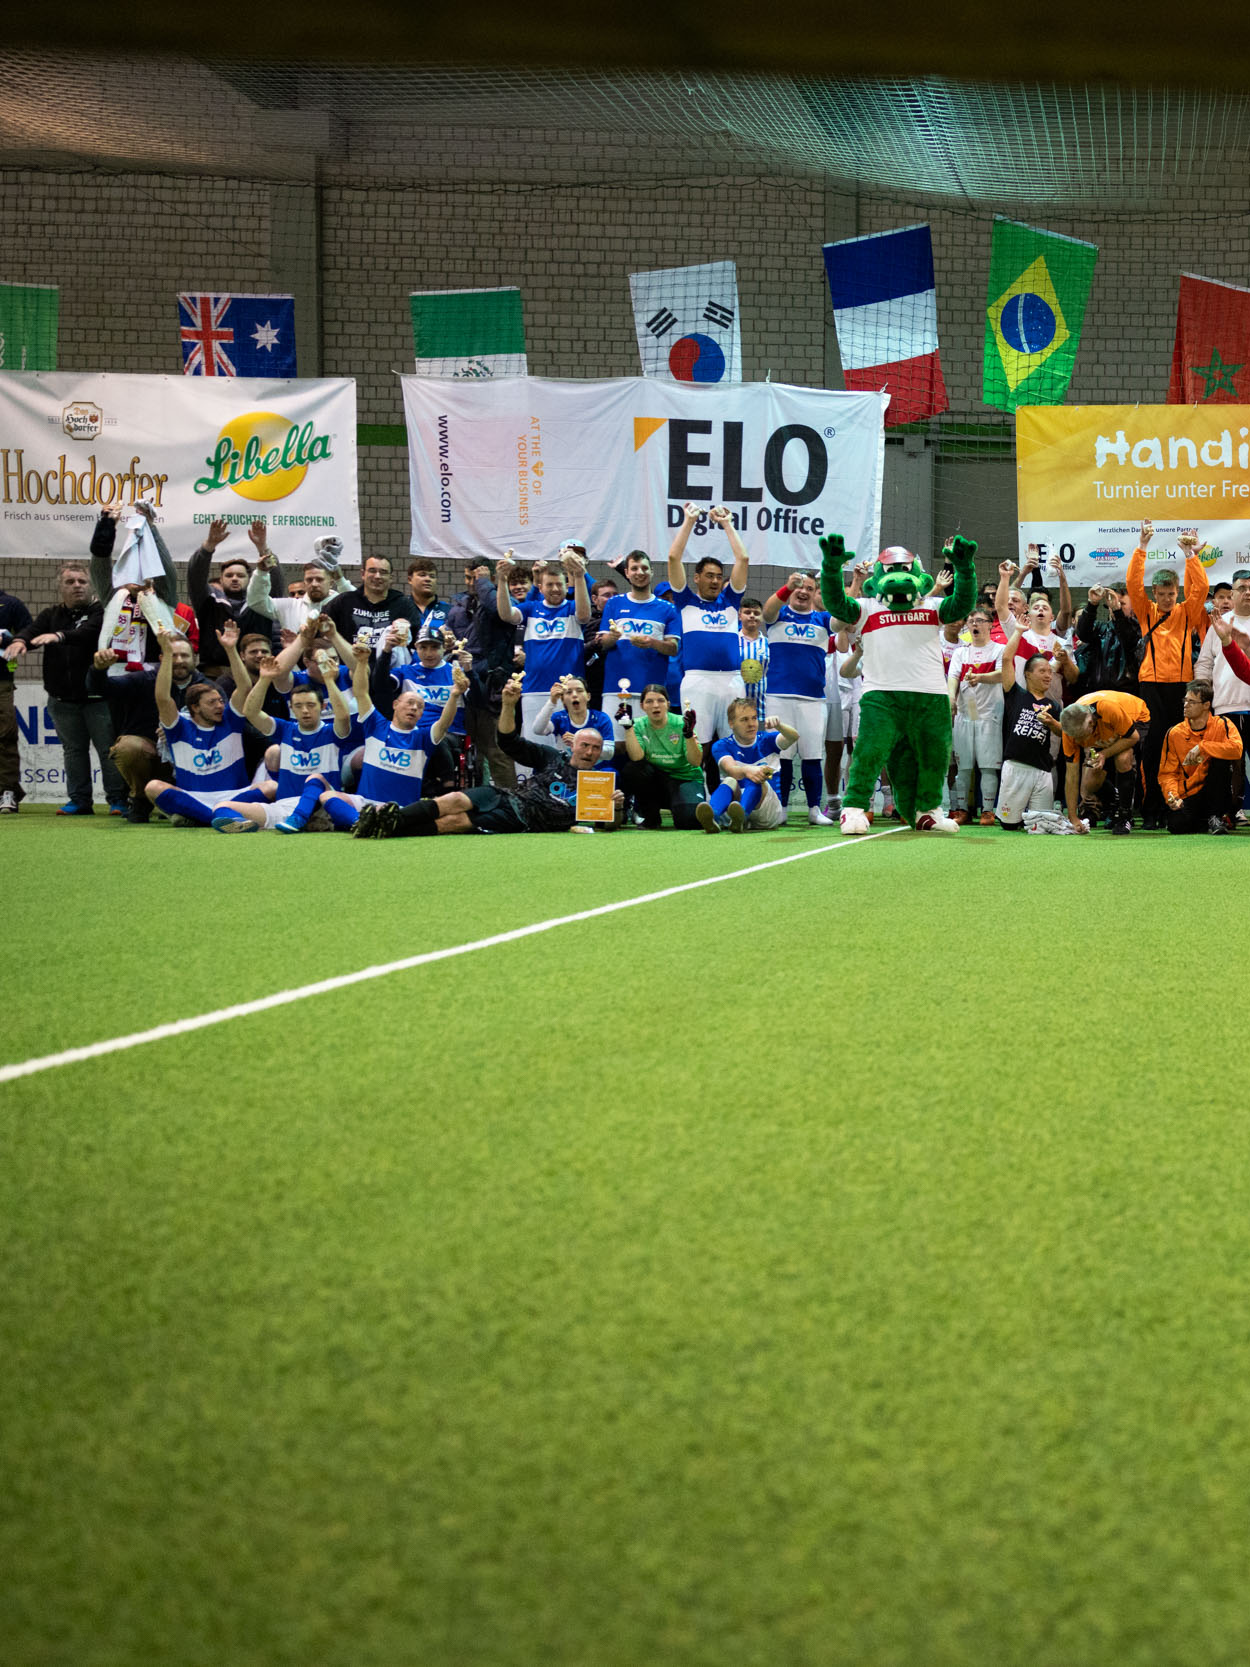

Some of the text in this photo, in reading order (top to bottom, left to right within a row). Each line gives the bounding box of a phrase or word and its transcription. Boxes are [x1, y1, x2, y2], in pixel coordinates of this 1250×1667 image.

[193, 420, 331, 494] Libella
[530, 416, 542, 496] AT THE OF
[668, 418, 828, 506] ELO
[438, 415, 453, 523] www.elo.com
[0, 449, 168, 507] Hochdorfer
[517, 434, 529, 526] YOUR BUSINESS
[1093, 481, 1160, 498] Turnier
[1165, 482, 1216, 498] unter
[4, 511, 31, 521] Frisch
[34, 513, 50, 521] aus
[53, 513, 95, 522] unserem
[273, 515, 337, 527] ERFRISCHEND.
[667, 504, 824, 536] Dgial Office
[1037, 543, 1075, 563] EO
[1148, 549, 1176, 559] ebix
[1198, 547, 1223, 562] bella
[535, 620, 565, 633] OWB
[702, 613, 728, 625] OWB
[879, 612, 930, 624] STUTTGART
[622, 620, 653, 634] OWB
[785, 624, 815, 638] OWB
[193, 750, 223, 767] OWB
[290, 752, 321, 767] OWB
[378, 747, 411, 767] OWB
